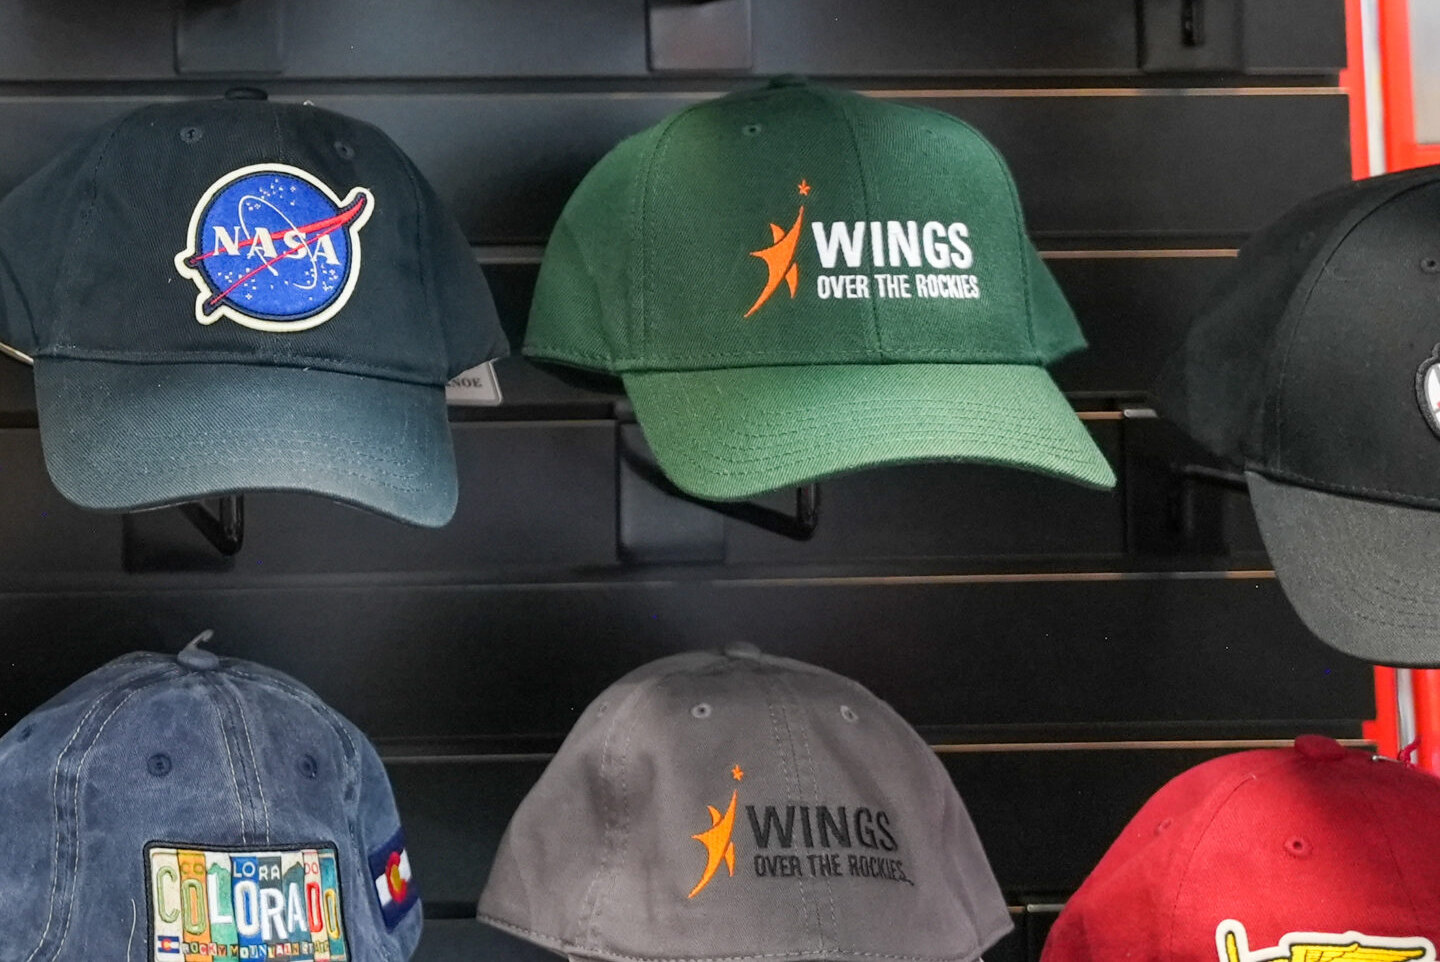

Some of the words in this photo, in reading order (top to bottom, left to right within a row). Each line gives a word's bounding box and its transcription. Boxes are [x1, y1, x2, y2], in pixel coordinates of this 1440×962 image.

[212, 225, 342, 266] NASA
[811, 220, 974, 270] WINGS
[816, 274, 871, 300] OVER
[873, 273, 912, 299] THE
[915, 274, 981, 300] ROCKIES
[745, 805, 899, 852] WINGS
[754, 854, 803, 878] OVER
[807, 853, 844, 877] THE
[848, 854, 910, 884] ROCKIES
[156, 864, 340, 941] COLORADO
[181, 942, 228, 956] ROCKY
[229, 942, 299, 959] MOUNTAIN
